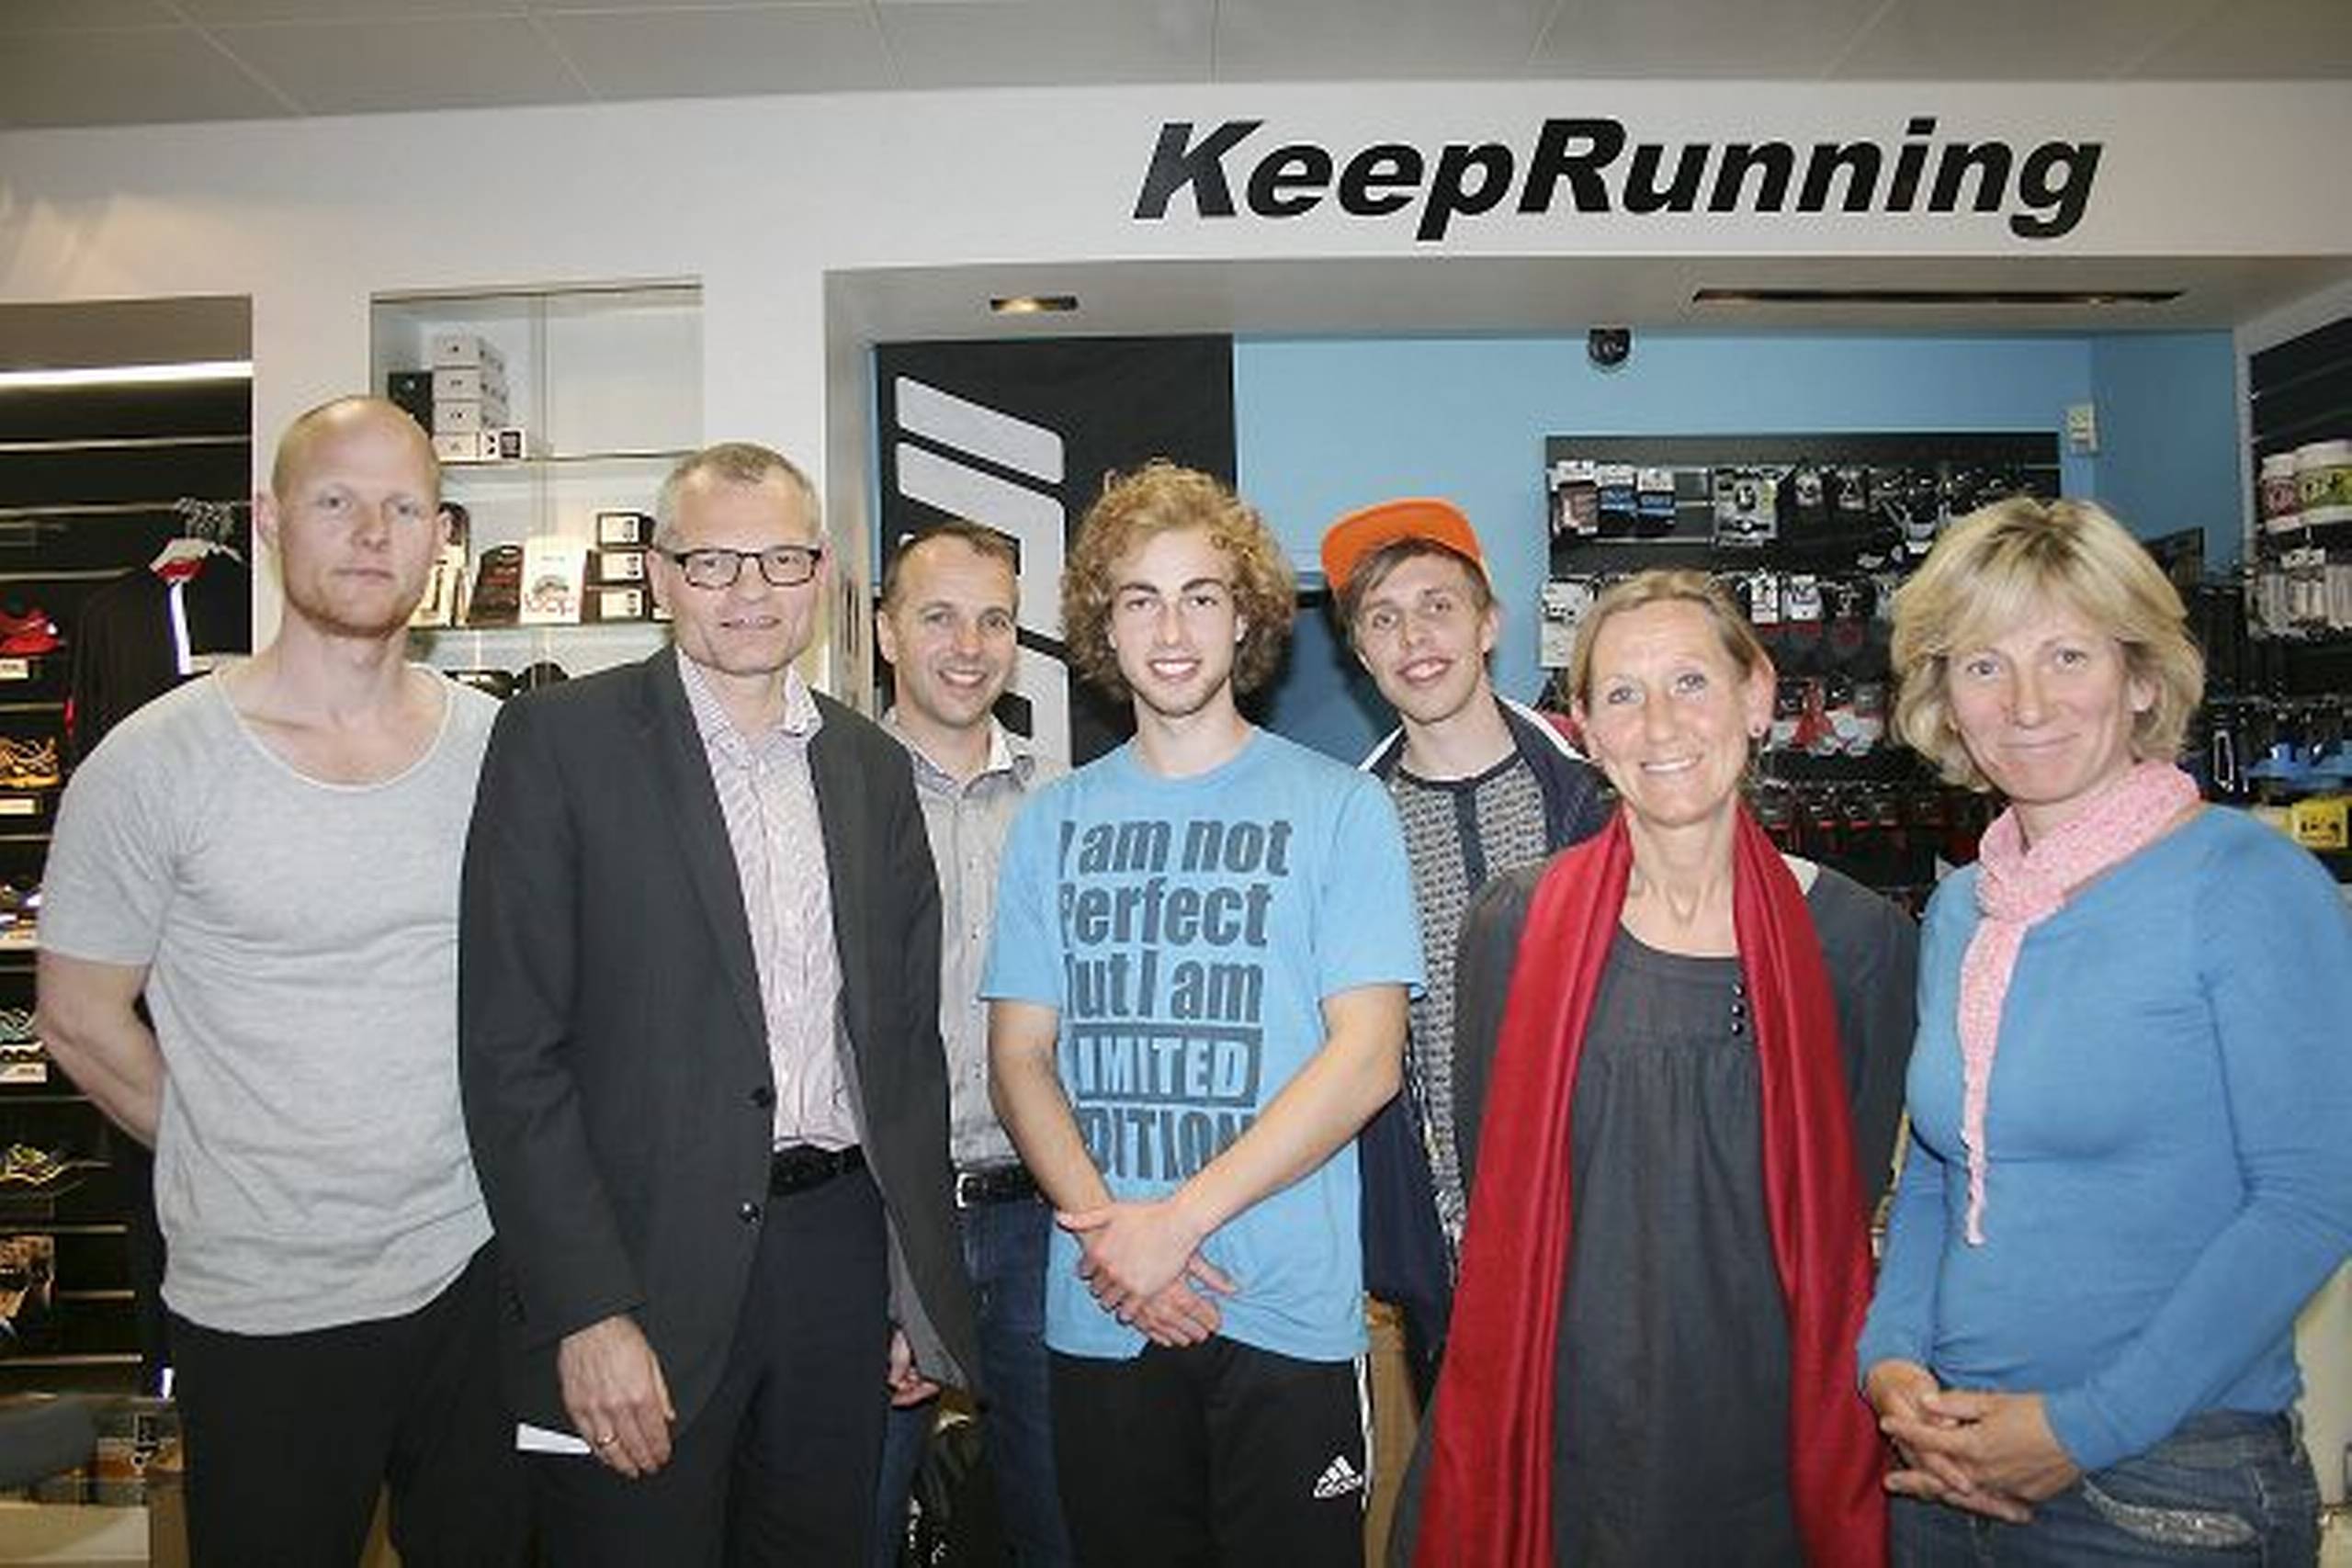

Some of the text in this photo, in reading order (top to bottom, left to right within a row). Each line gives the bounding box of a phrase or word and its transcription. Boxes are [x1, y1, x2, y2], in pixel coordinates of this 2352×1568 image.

[1134, 117, 2102, 242] KeepRunning
[1079, 820, 1172, 874] am
[1182, 819, 1293, 876] not
[1137, 950, 1159, 1017] I
[1170, 958, 1264, 1022] am
[1073, 1035, 1250, 1098] IMITED
[1077, 1107, 1256, 1181] DITIO
